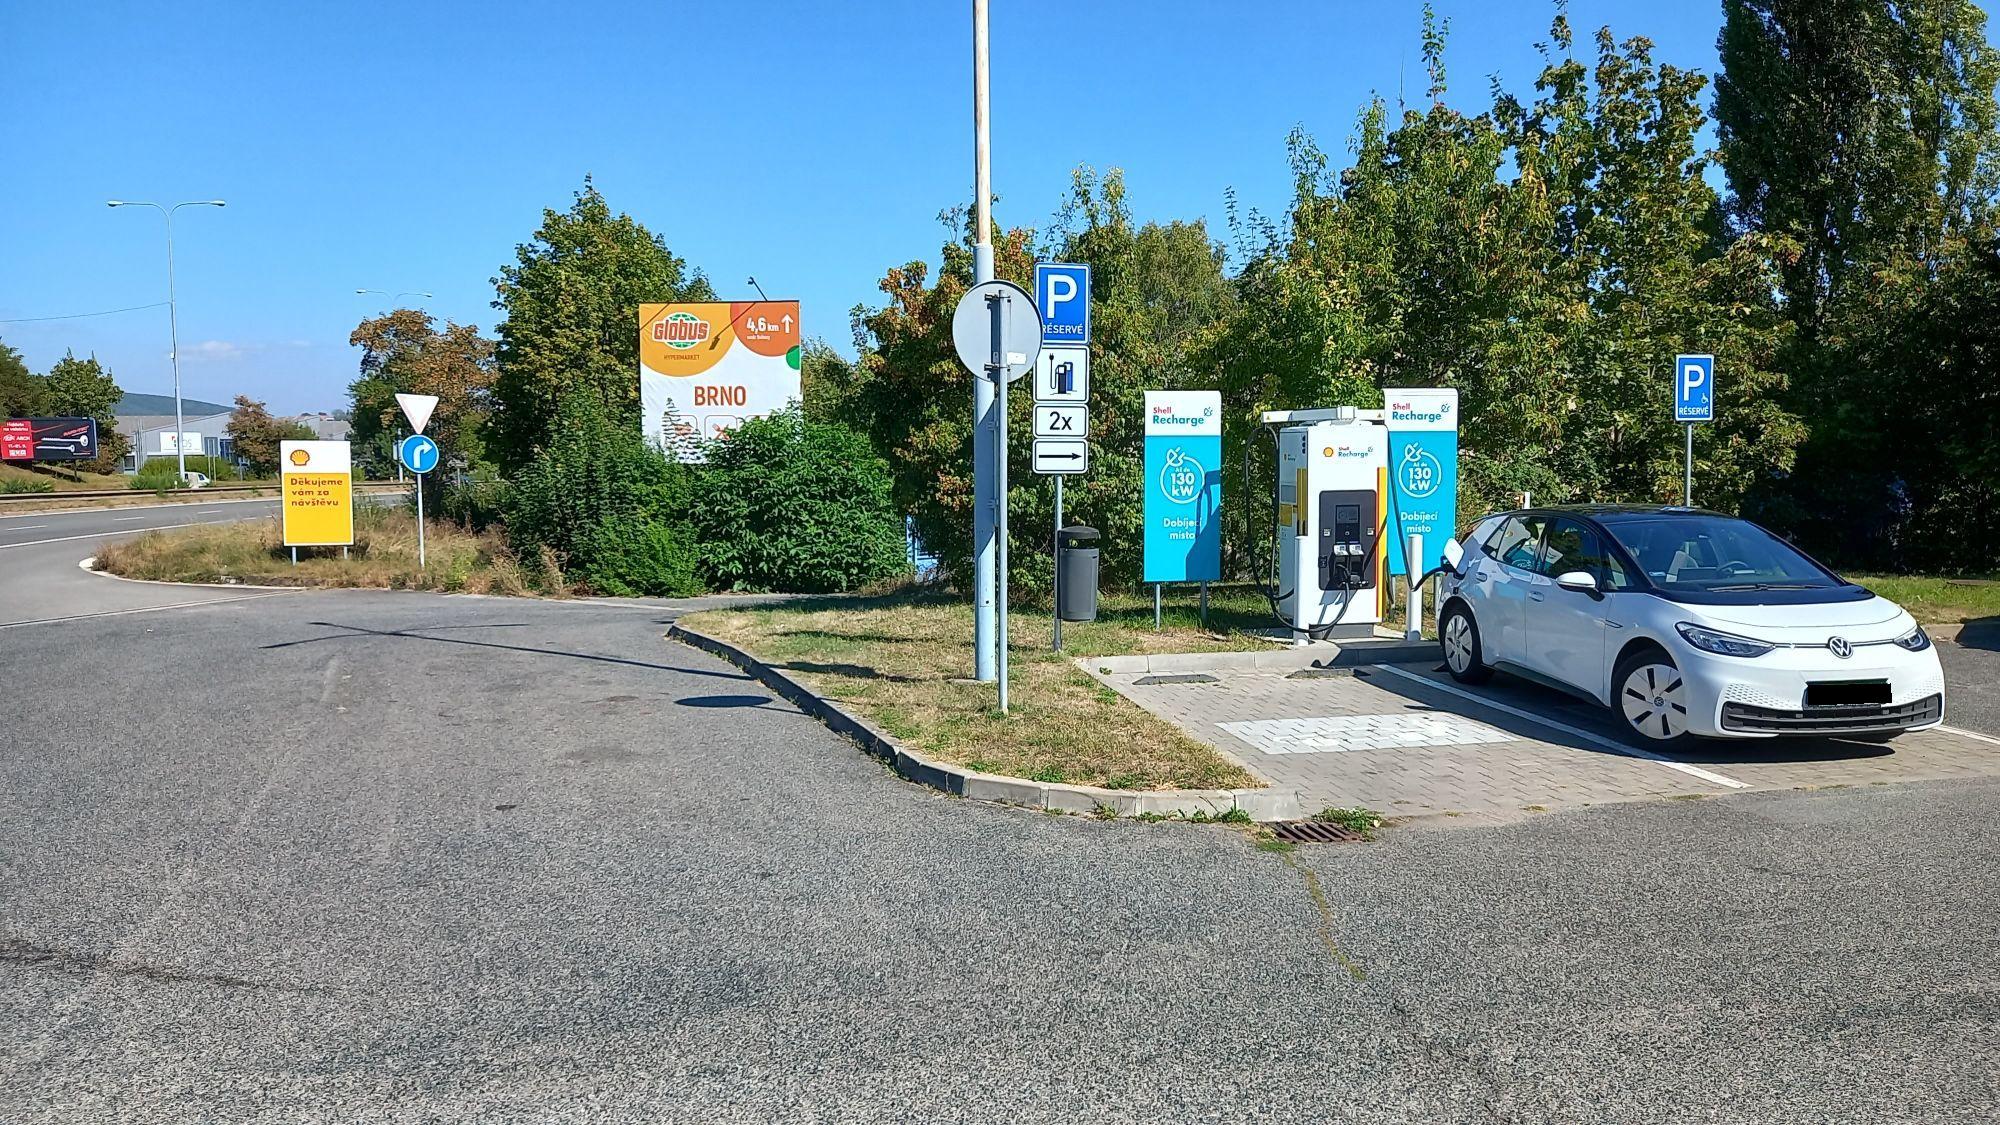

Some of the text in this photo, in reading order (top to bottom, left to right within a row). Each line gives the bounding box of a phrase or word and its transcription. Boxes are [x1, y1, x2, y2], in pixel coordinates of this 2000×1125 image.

[1047, 274, 1078, 318] P
[746, 317, 779, 334] 4,6 km
[1042, 322, 1084, 334] RÉSERVÉ
[1683, 364, 1705, 401] P
[694, 385, 747, 406] BRNO
[1153, 406, 1172, 414] Shell
[1392, 403, 1411, 411] Shell
[1678, 405, 1709, 416] RÉSERVÉ
[1049, 410, 1073, 431] 2x
[1152, 415, 1205, 427] Recharge
[1392, 411, 1442, 423] Recharge
[1170, 472, 1195, 485] 130
[1408, 467, 1432, 480] 130
[290, 477, 343, 487] Děkujeme
[1409, 479, 1431, 491] kW
[292, 487, 314, 496] vám
[1171, 484, 1194, 497] kW
[291, 498, 339, 506] návštěvu
[1400, 511, 1438, 523] Dobíjecí
[1406, 524, 1431, 533] místo
[1169, 531, 1196, 540] místo
